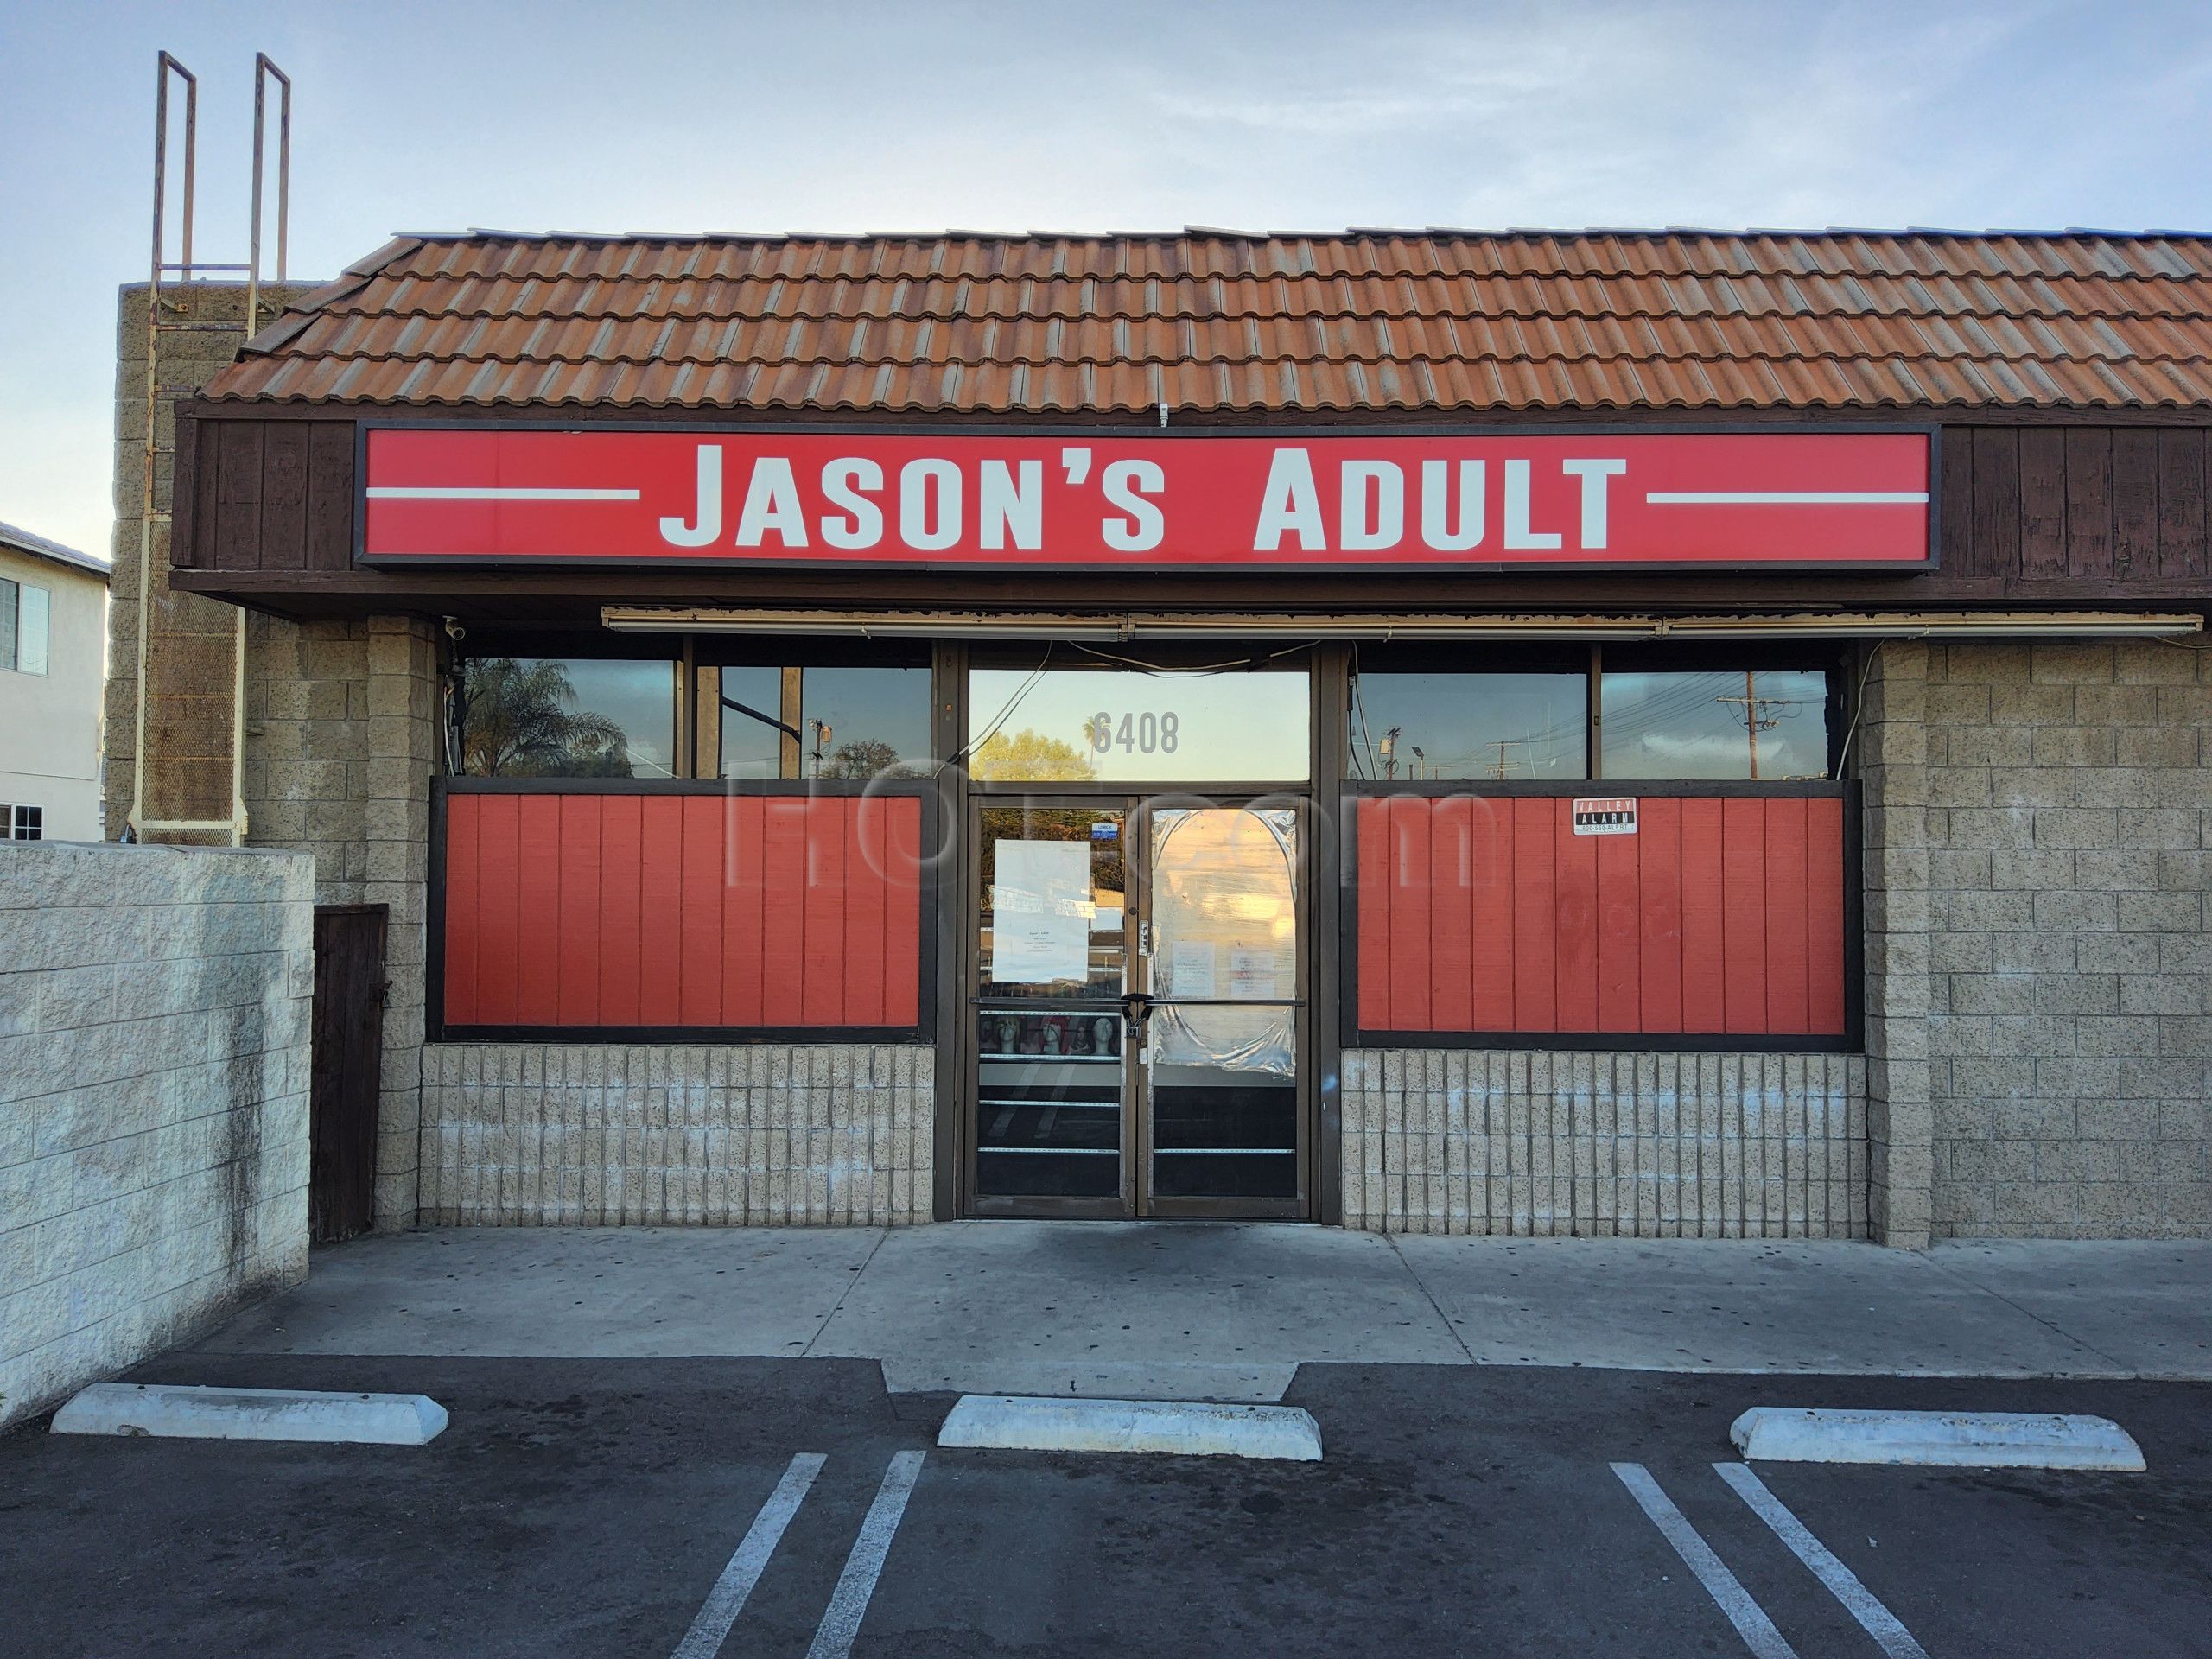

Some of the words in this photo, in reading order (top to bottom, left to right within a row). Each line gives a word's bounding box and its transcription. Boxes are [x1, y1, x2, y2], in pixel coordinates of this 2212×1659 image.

[659, 444, 1165, 551] JASON'S
[1253, 448, 1627, 551] ADULT
[1094, 711, 1179, 754] 6408
[1579, 800, 1631, 812] VALLEY
[1582, 812, 1629, 824] ALARM
